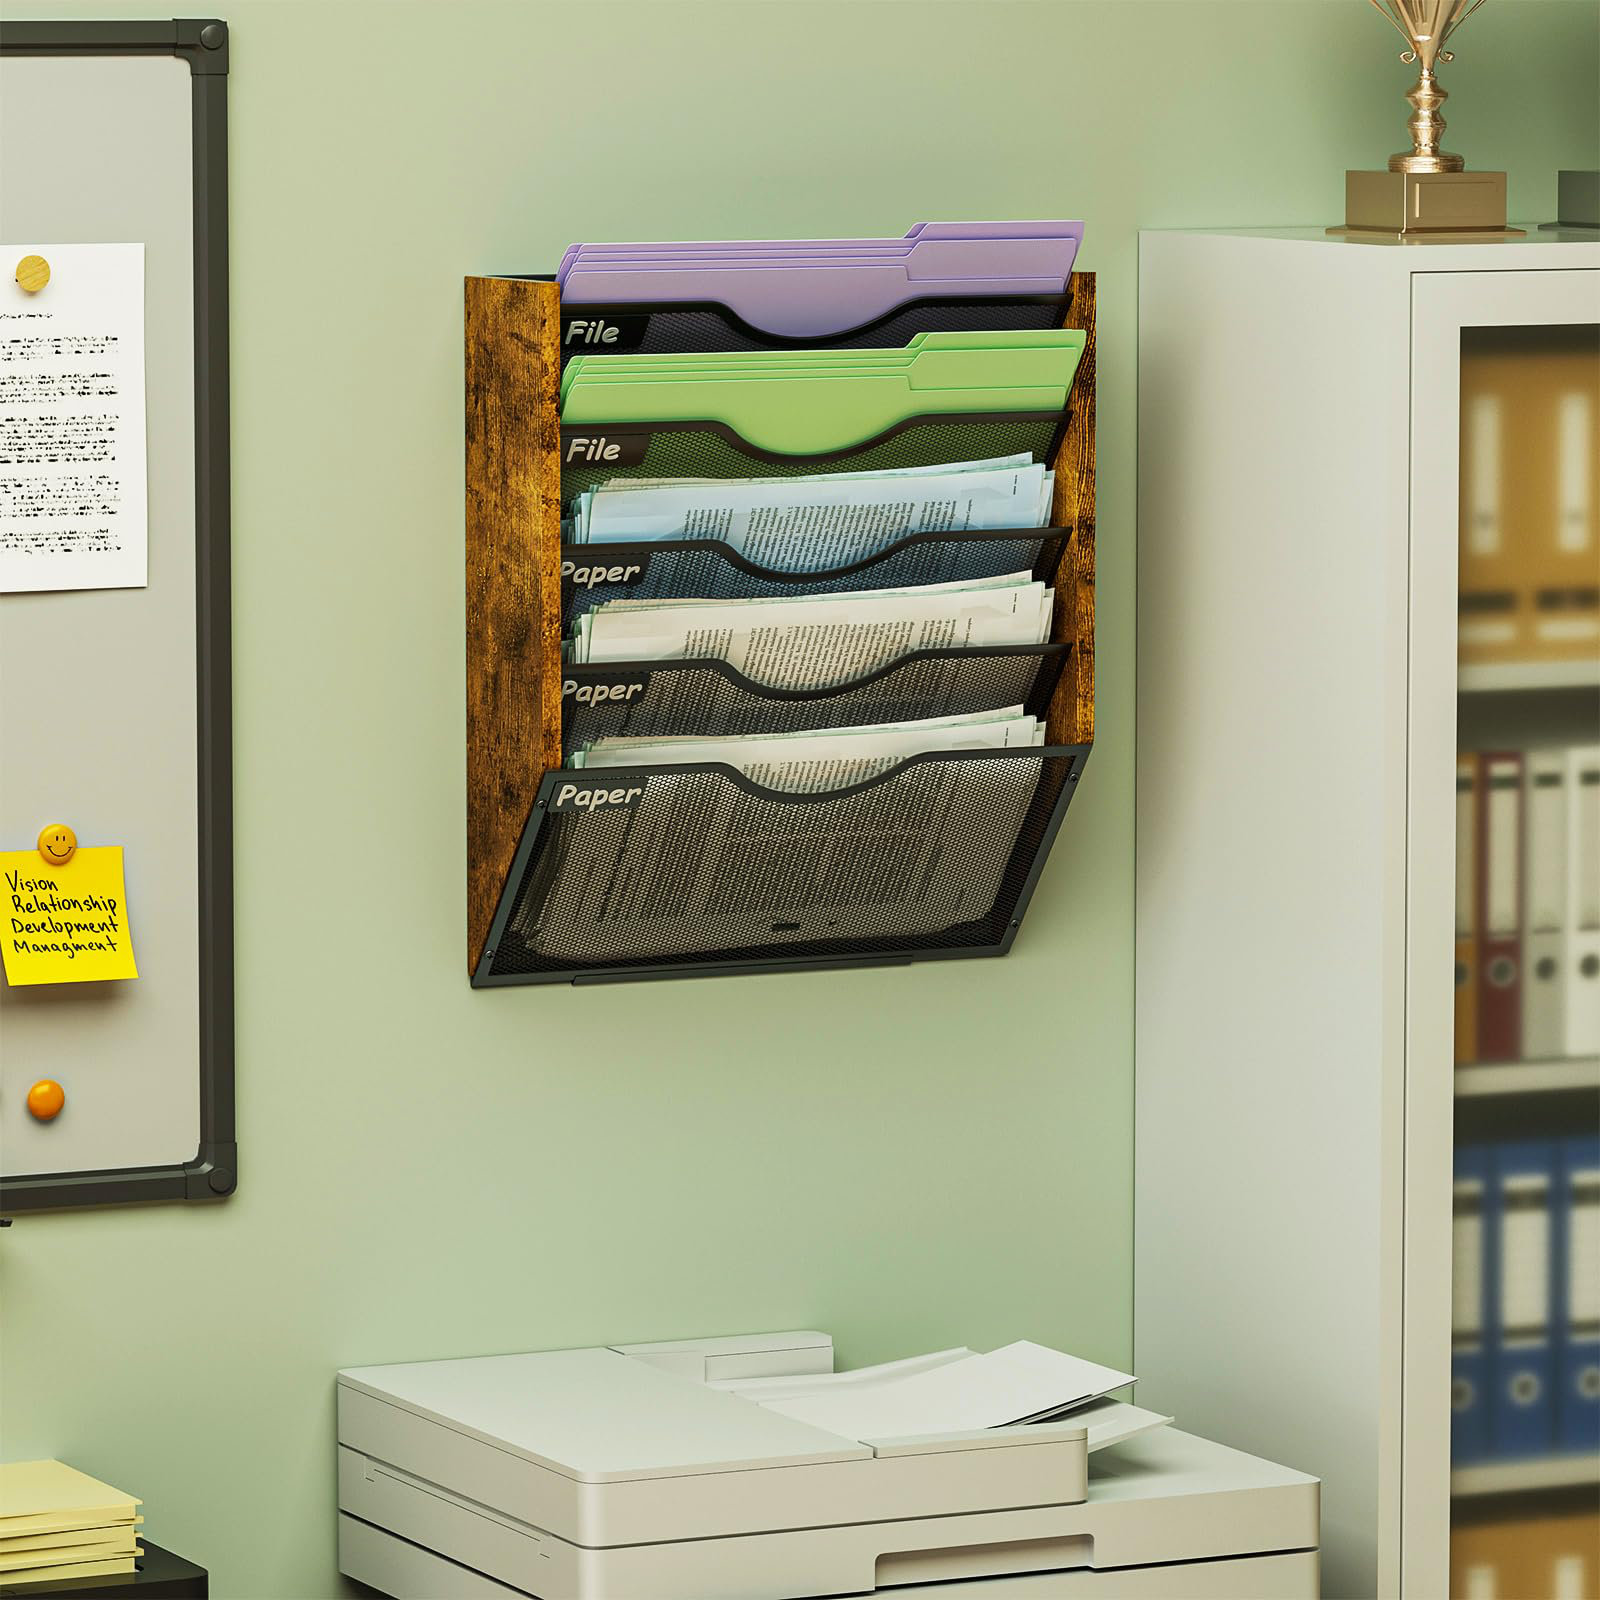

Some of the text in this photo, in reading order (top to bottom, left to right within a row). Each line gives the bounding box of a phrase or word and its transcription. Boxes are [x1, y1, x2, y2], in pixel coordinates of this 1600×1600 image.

[565, 320, 619, 345] File
[566, 437, 621, 462] File
[561, 561, 641, 589] Paper
[561, 680, 642, 707] Paper
[557, 784, 642, 811] Paper
[5, 869, 58, 892] Vision
[11, 894, 117, 917] Relationship
[11, 915, 119, 939] Development
[13, 935, 118, 959] Managment
